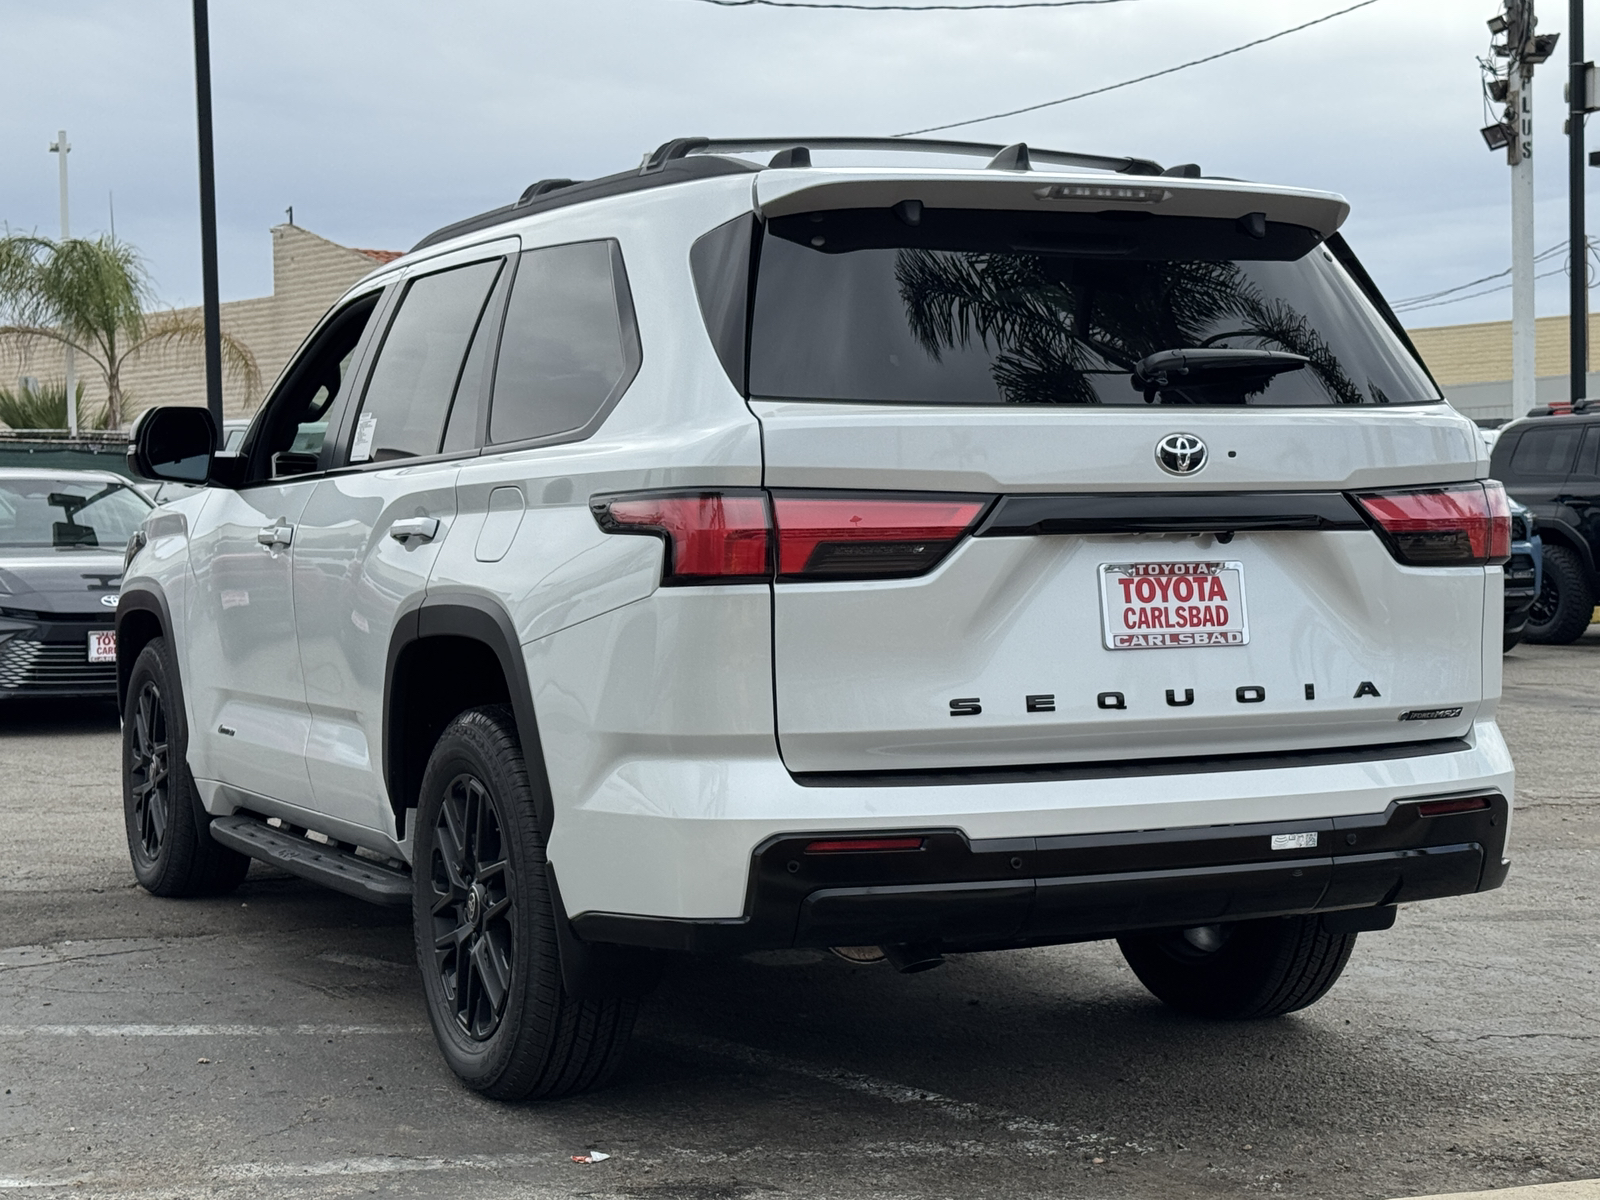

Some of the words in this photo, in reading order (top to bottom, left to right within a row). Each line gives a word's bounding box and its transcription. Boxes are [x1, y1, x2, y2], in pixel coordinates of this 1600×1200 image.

[1137, 563, 1209, 576] TOYOTA
[1118, 576, 1228, 604] TOYOTA
[1123, 605, 1229, 630] CARLSBAD
[96, 635, 116, 646] TOY
[1114, 632, 1242, 648] CARLSBAD
[949, 680, 1382, 717] SEQUOIA
